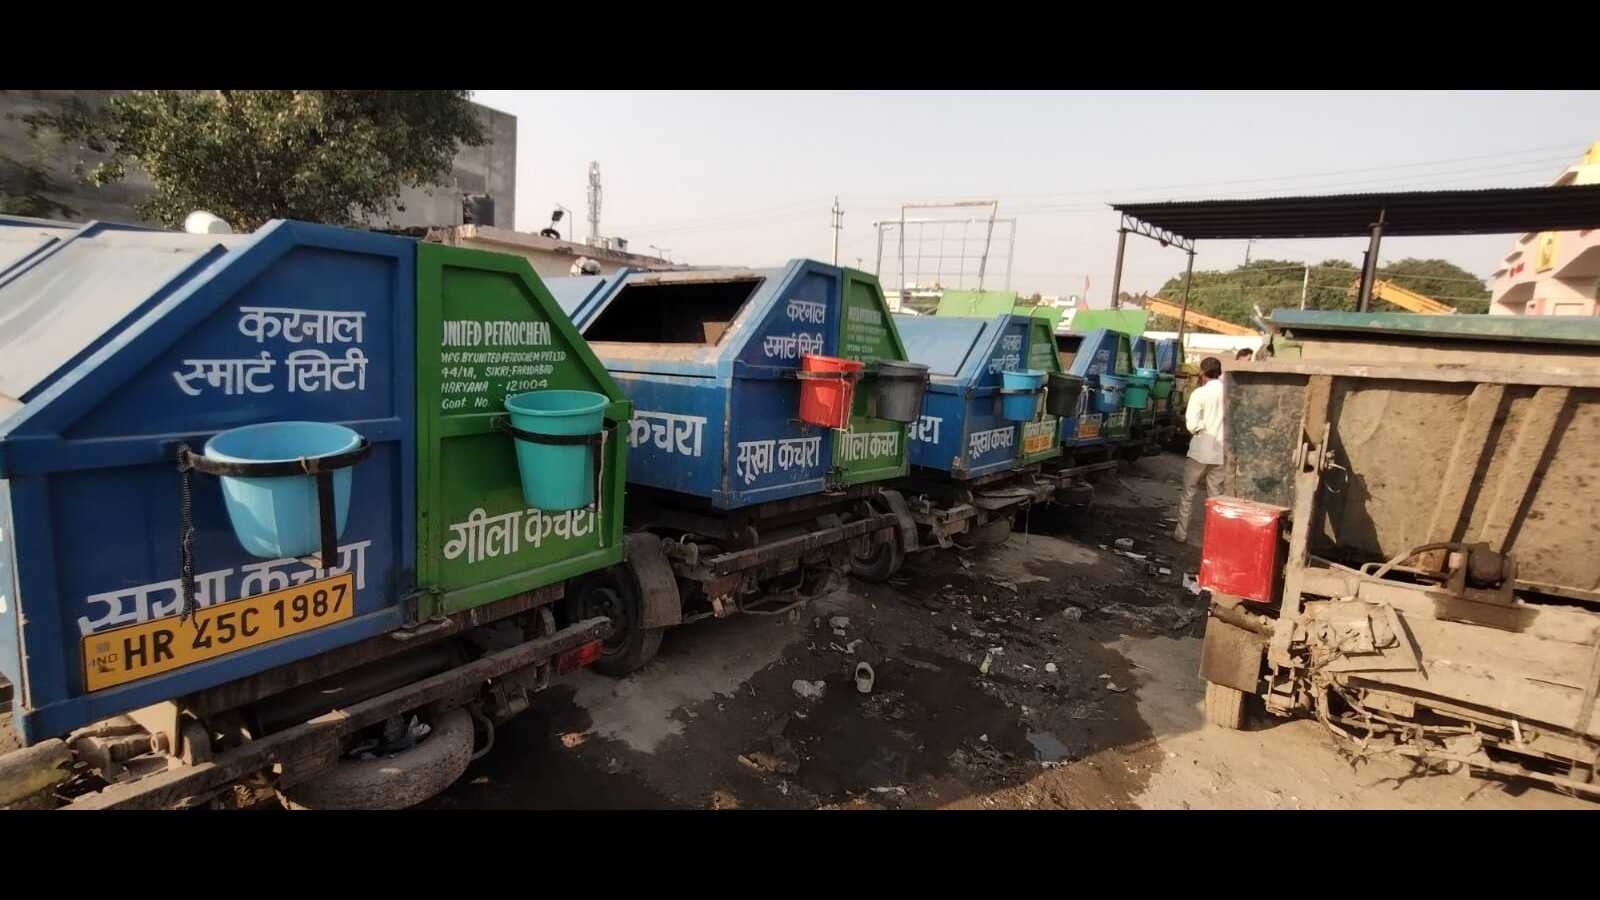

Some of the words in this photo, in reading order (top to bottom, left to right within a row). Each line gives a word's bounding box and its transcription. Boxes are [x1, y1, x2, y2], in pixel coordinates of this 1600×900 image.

[238, 306, 367, 344] करनाल
[787, 299, 826, 324] करनाल
[484, 320, 552, 346] PETROCHEM
[173, 351, 276, 396] स्मार्ट
[285, 348, 369, 393] सिटी
[441, 381, 489, 393] HARYANA
[505, 380, 548, 391] 121004
[474, 397, 488, 409] No
[736, 440, 776, 485] सूखा
[778, 436, 822, 471] कचरा
[443, 507, 524, 564] गीला
[123, 629, 175, 671] HR
[191, 608, 260, 650] 45C
[273, 583, 348, 628] 1987
